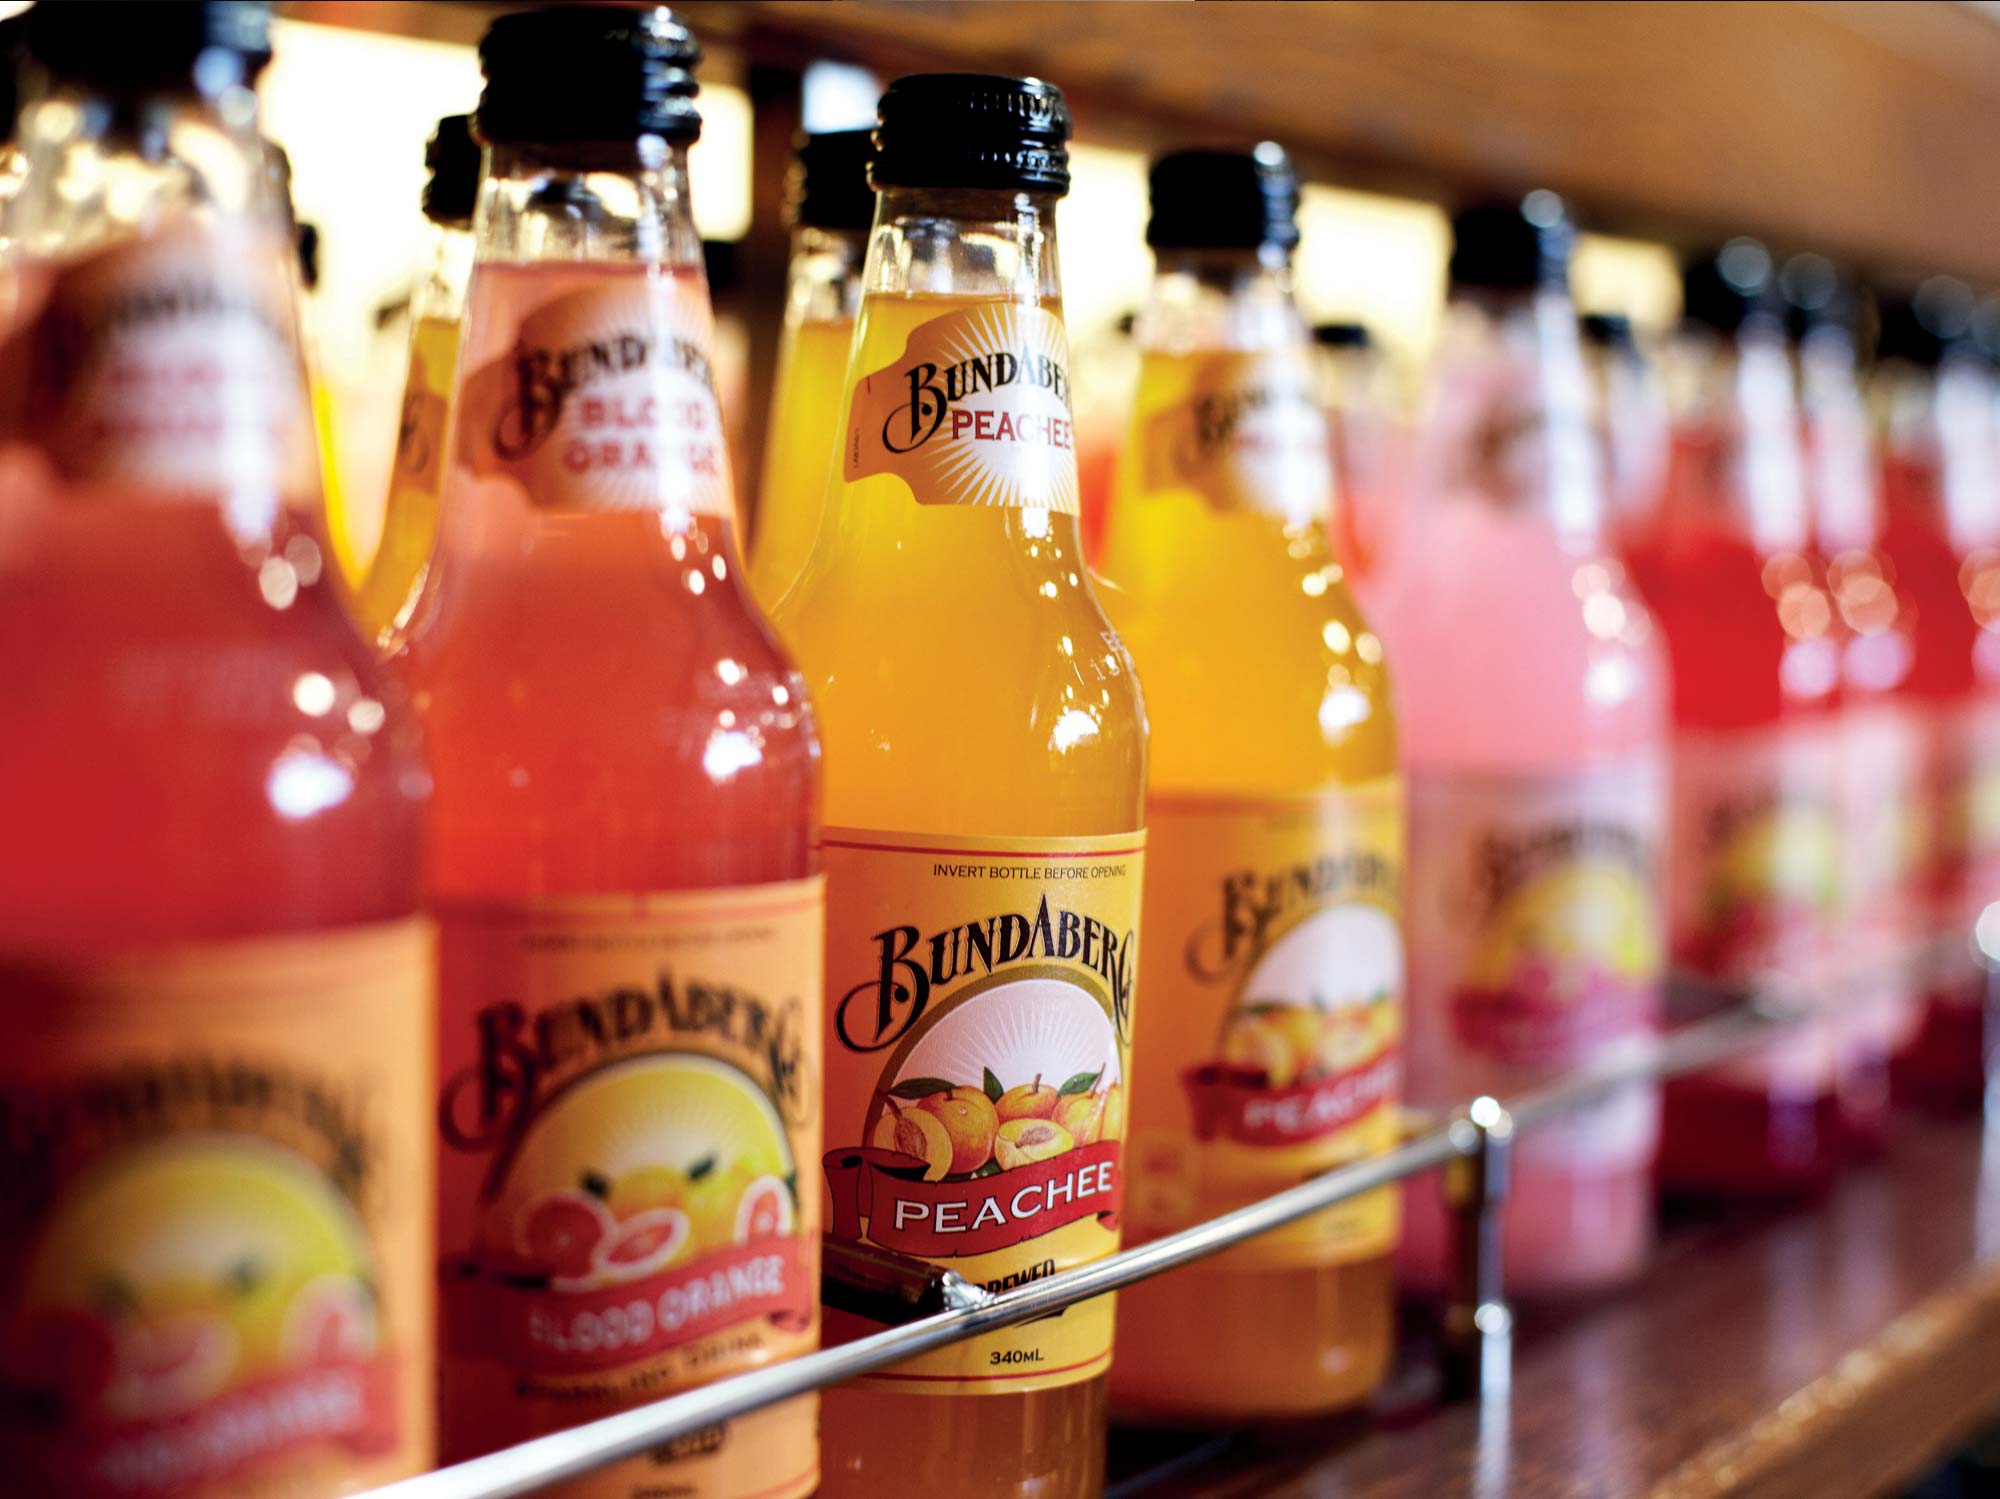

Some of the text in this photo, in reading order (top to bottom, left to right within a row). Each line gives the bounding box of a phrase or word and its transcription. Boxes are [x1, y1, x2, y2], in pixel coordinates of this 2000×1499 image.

[933, 863, 1127, 880] INVERT BOTTLE BEFORE OPENING
[834, 892, 1135, 1053] BUNDABERG
[893, 1160, 1115, 1234] PEACHEE
[973, 1258, 1055, 1294] REWED
